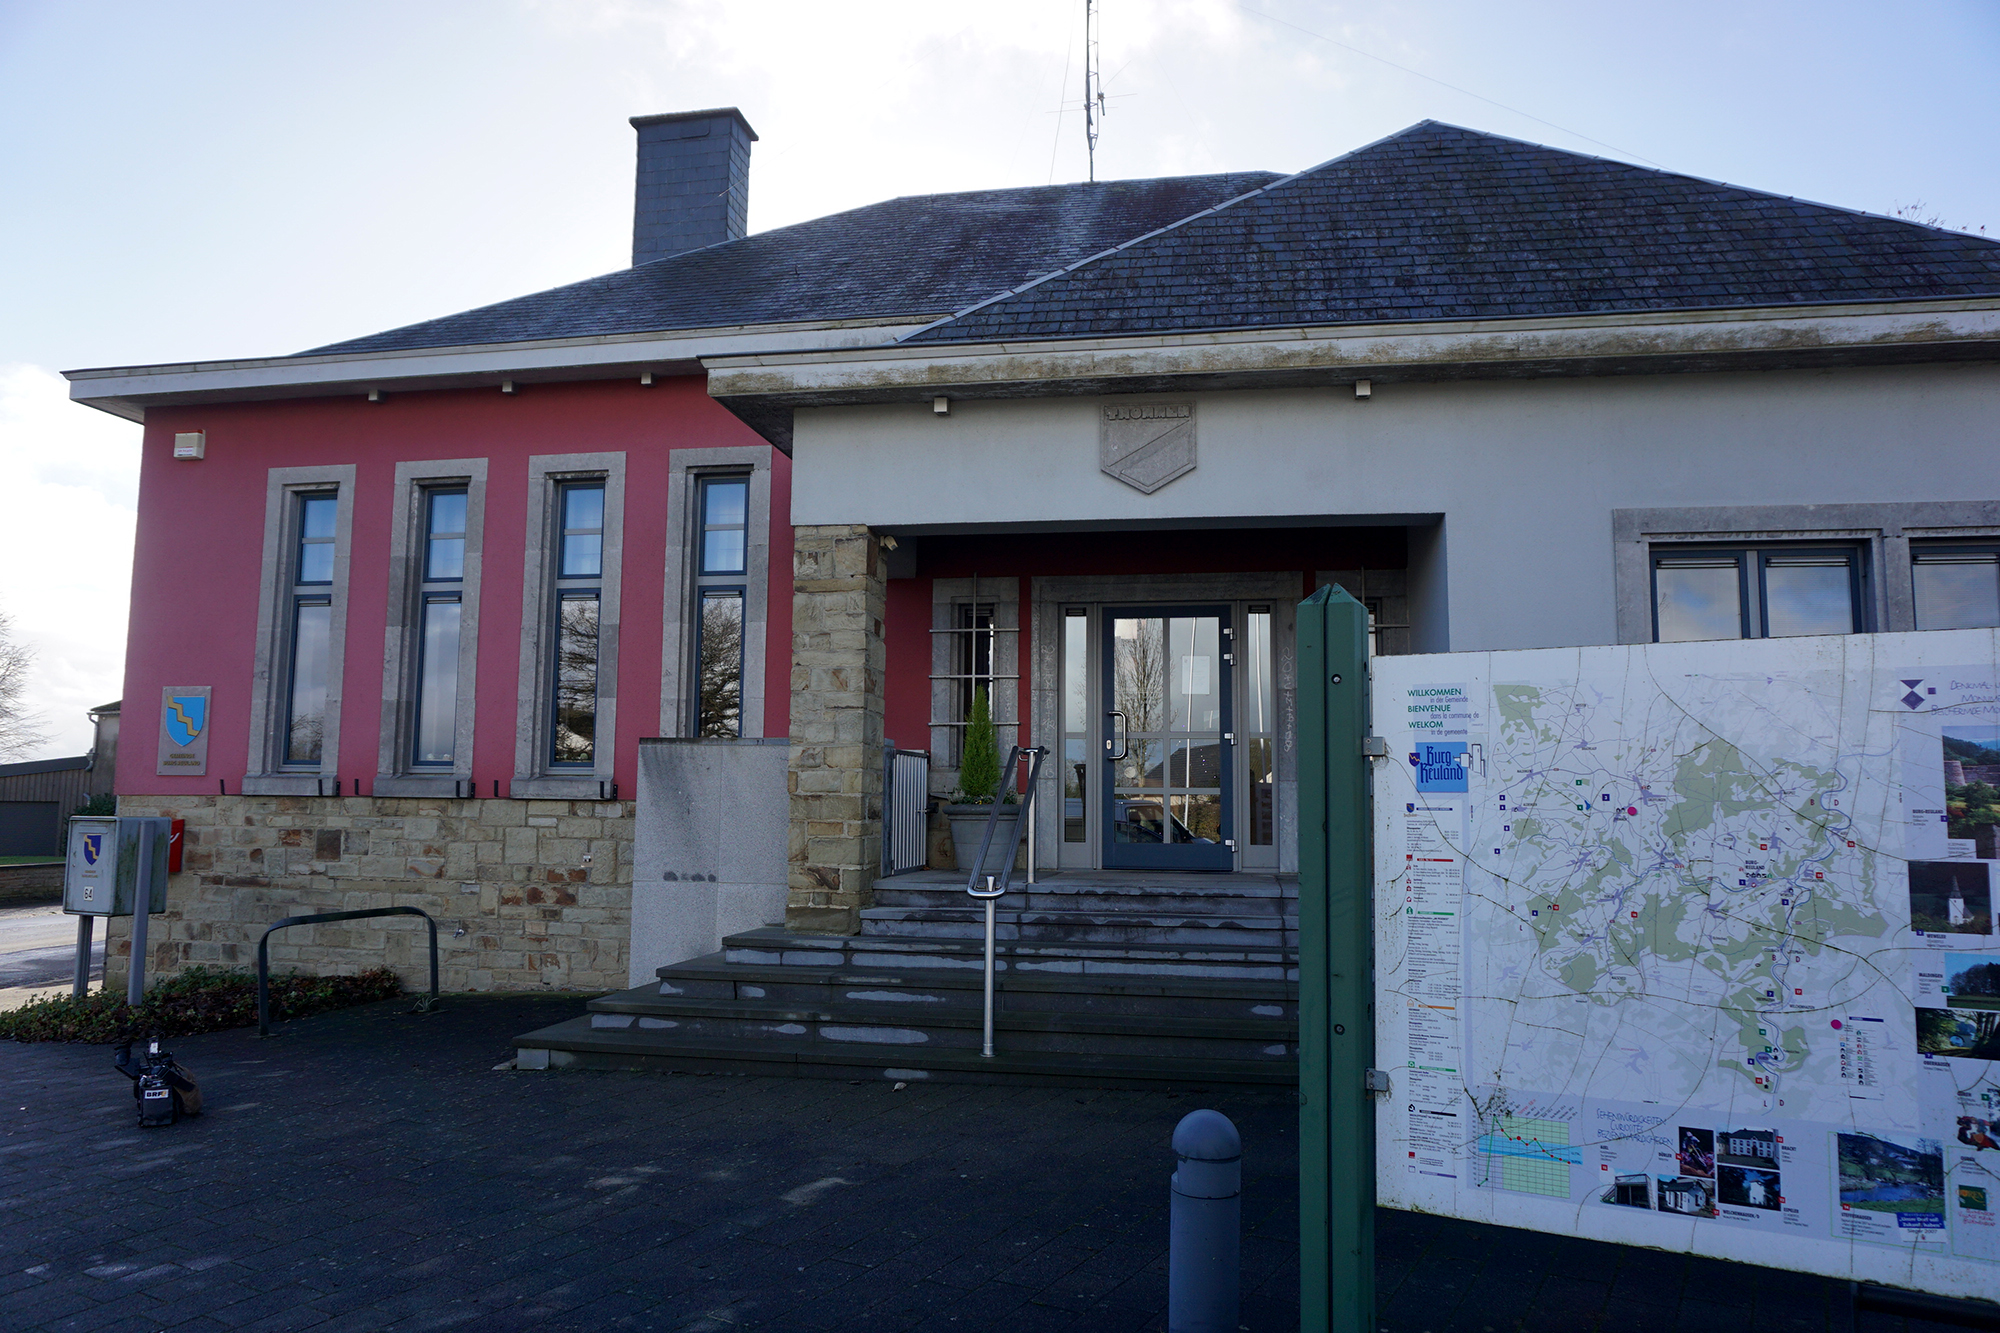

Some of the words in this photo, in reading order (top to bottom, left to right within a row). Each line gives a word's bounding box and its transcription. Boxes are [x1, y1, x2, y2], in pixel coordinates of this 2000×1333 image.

[1106, 405, 1191, 421] THOMMEN
[1407, 688, 1462, 697] WILLKOMMEN
[1408, 704, 1451, 712] BIENVENUE
[1444, 729, 1468, 737] gemeente
[1426, 745, 1451, 766] Burg
[84, 888, 93, 899] 64
